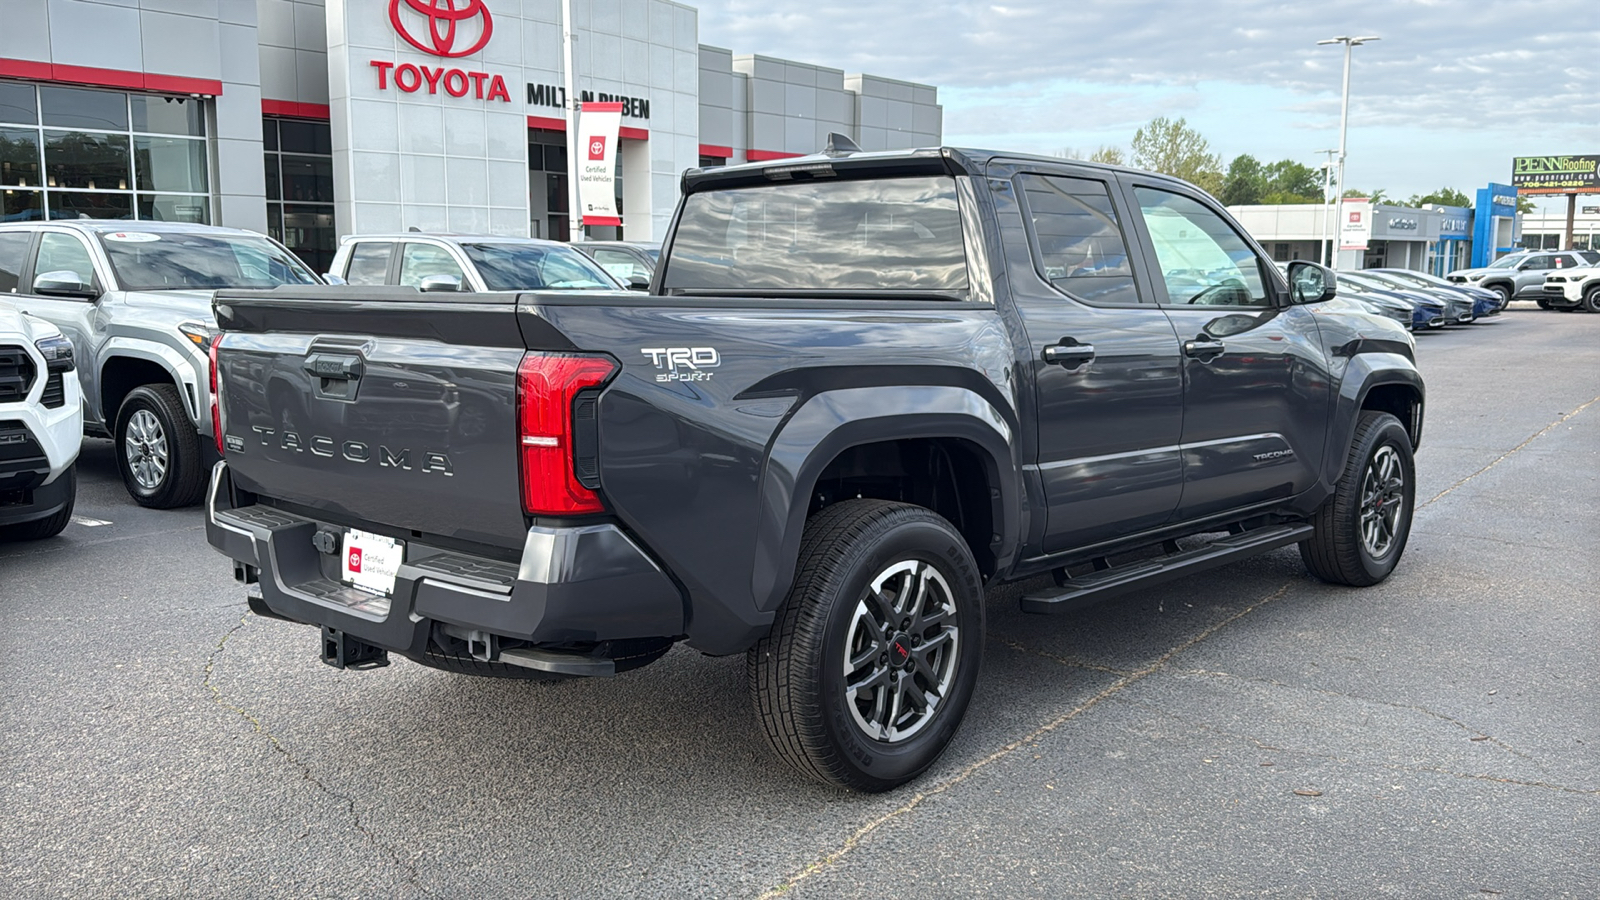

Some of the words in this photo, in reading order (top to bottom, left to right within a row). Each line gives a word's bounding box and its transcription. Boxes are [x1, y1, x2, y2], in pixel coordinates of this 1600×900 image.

[370, 60, 511, 102] TOYOTA
[527, 83, 594, 109] MILTN
[1514, 156, 1564, 171] PENN
[1563, 157, 1596, 172] Roofing
[1514, 173, 1595, 182] www.pennroof.com
[641, 347, 718, 370] TRD
[656, 372, 714, 382] SPORT
[252, 425, 454, 476] TACOMA
[1253, 448, 1294, 461] TACOMA
[364, 553, 385, 565] Certified
[364, 563, 376, 573] Used
